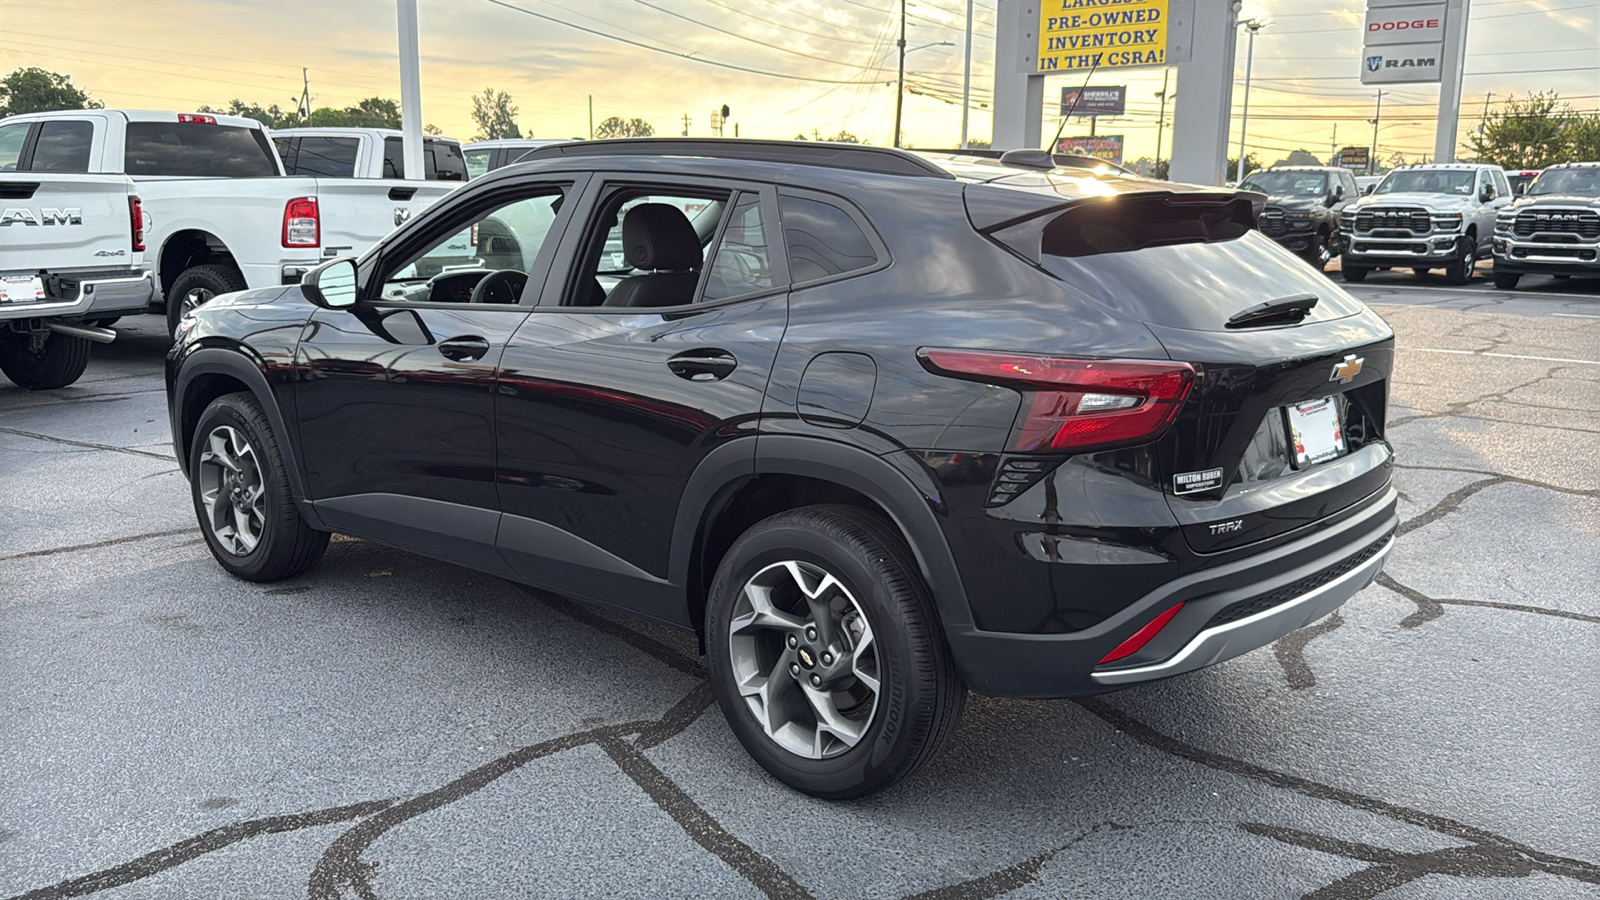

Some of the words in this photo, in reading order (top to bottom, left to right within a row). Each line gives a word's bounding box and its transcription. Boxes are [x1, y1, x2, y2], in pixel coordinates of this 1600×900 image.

[1047, 8, 1161, 31] PRE-OWNED
[1368, 19, 1439, 32] DODGE
[1048, 29, 1158, 51] INVENTORY
[1039, 57, 1059, 70] IN
[1064, 53, 1102, 68] THE
[1107, 49, 1164, 66] CSRA!
[1385, 58, 1436, 68] RAM
[1177, 473, 1202, 485] MILTON
[1209, 519, 1243, 535] TRAX
